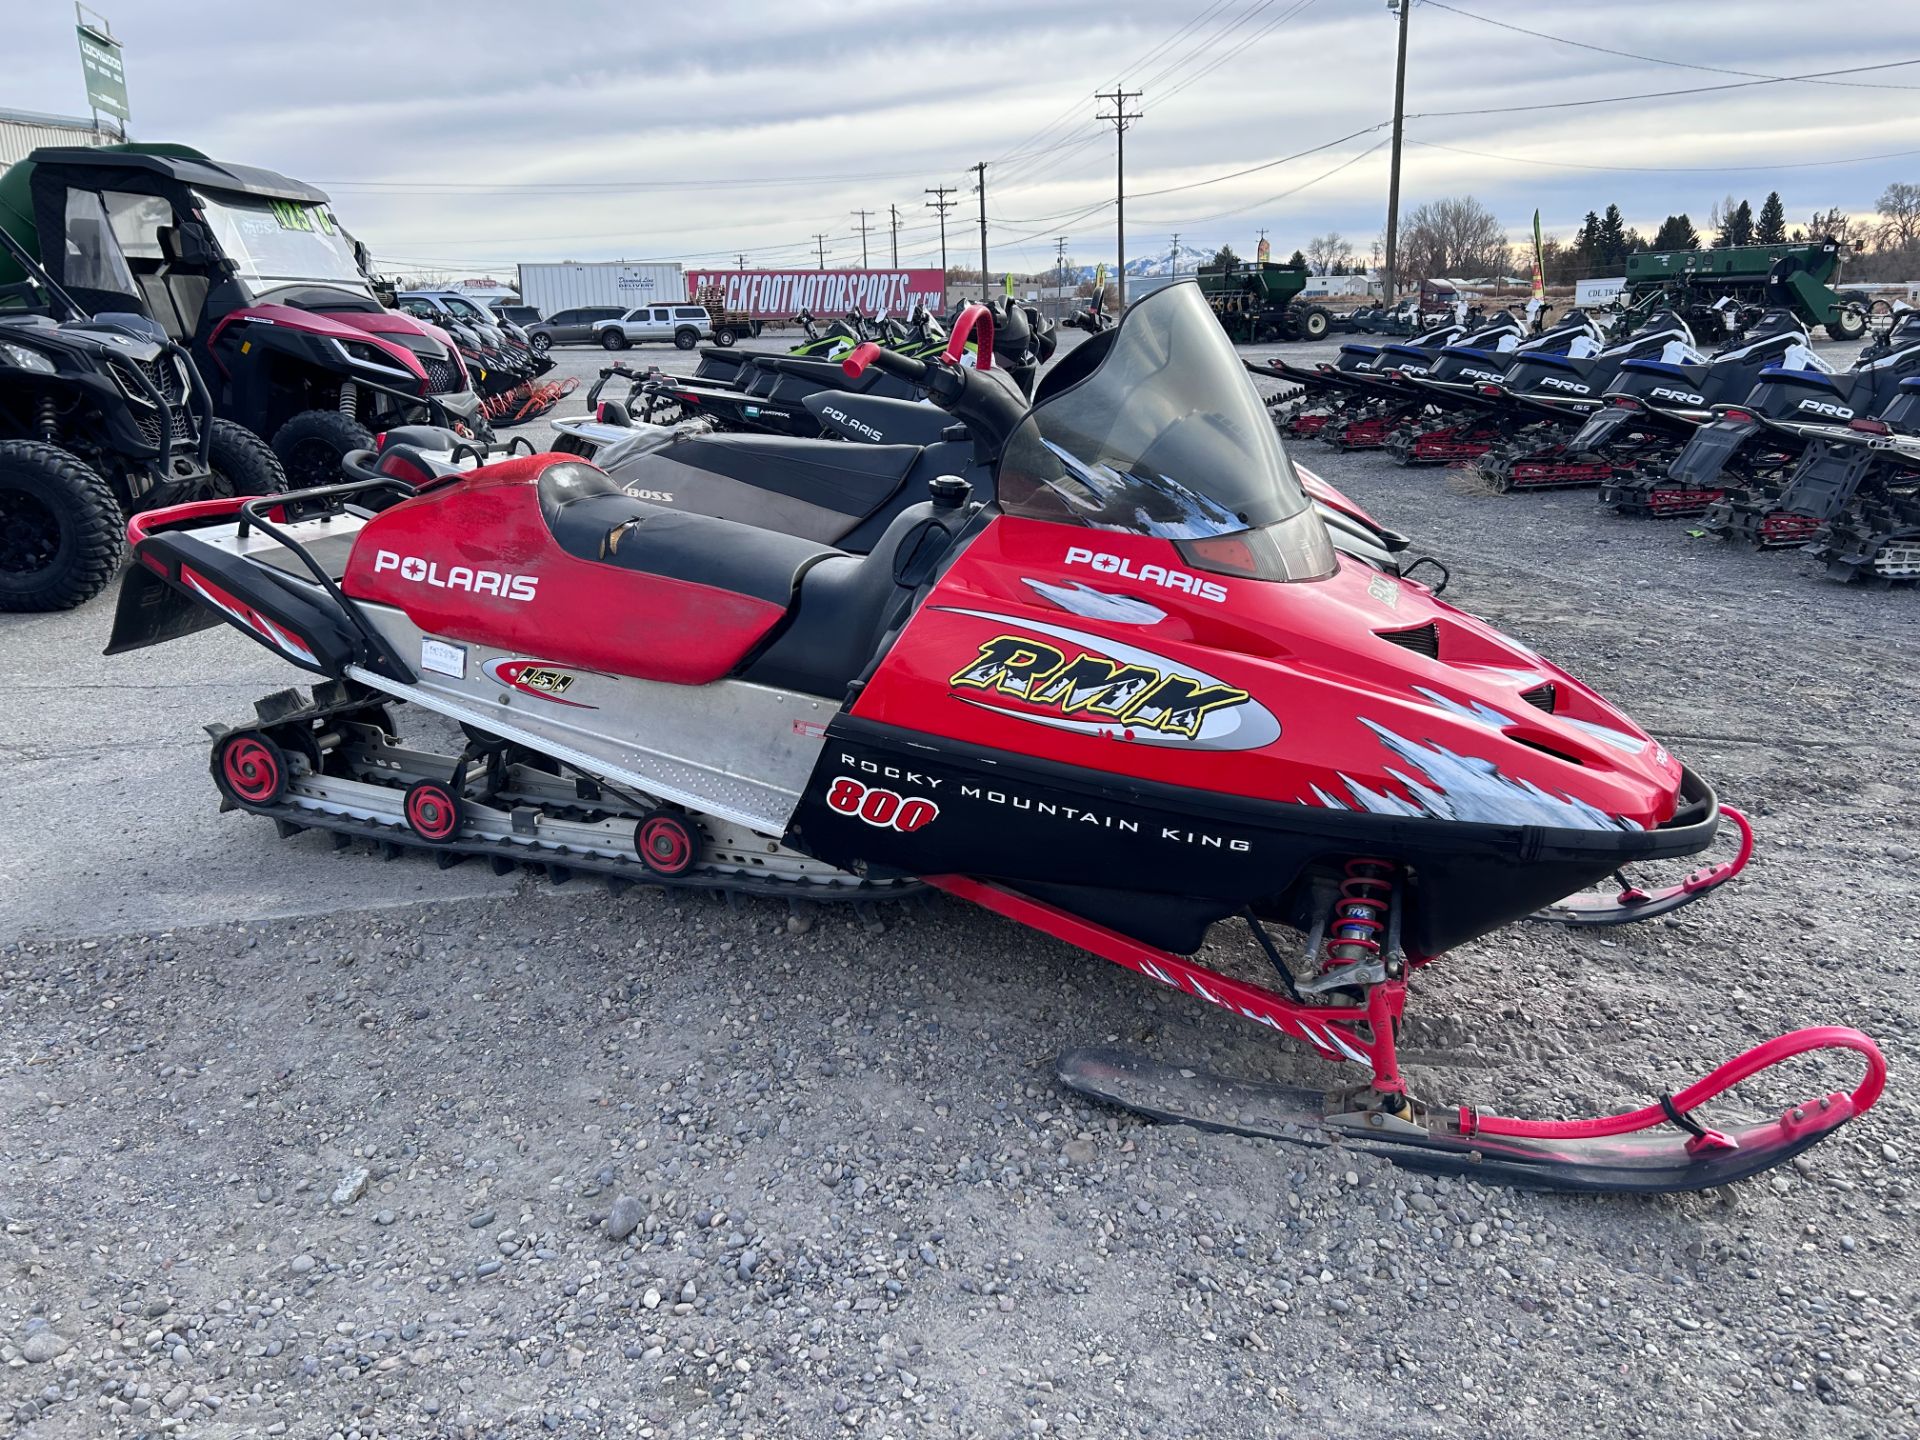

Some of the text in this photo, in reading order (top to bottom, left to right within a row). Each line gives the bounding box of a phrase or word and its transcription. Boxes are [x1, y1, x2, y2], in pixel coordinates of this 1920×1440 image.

[1588, 289, 1602, 297] CDL
[1398, 363, 1429, 376] PR
[1459, 367, 1504, 383] PRO
[1540, 376, 1590, 395] PRO
[1650, 387, 1704, 406] PRO
[1798, 399, 1855, 419] PRO
[821, 405, 883, 442] POLARIS
[627, 487, 674, 502] BOSS
[373, 549, 540, 602] POLARIS
[1063, 546, 1229, 603] POLARIS
[515, 666, 575, 694] 151
[949, 634, 1250, 740] RMK
[826, 775, 941, 833] 800
[840, 753, 1251, 852] ROCKY MOUNTAIN KING
